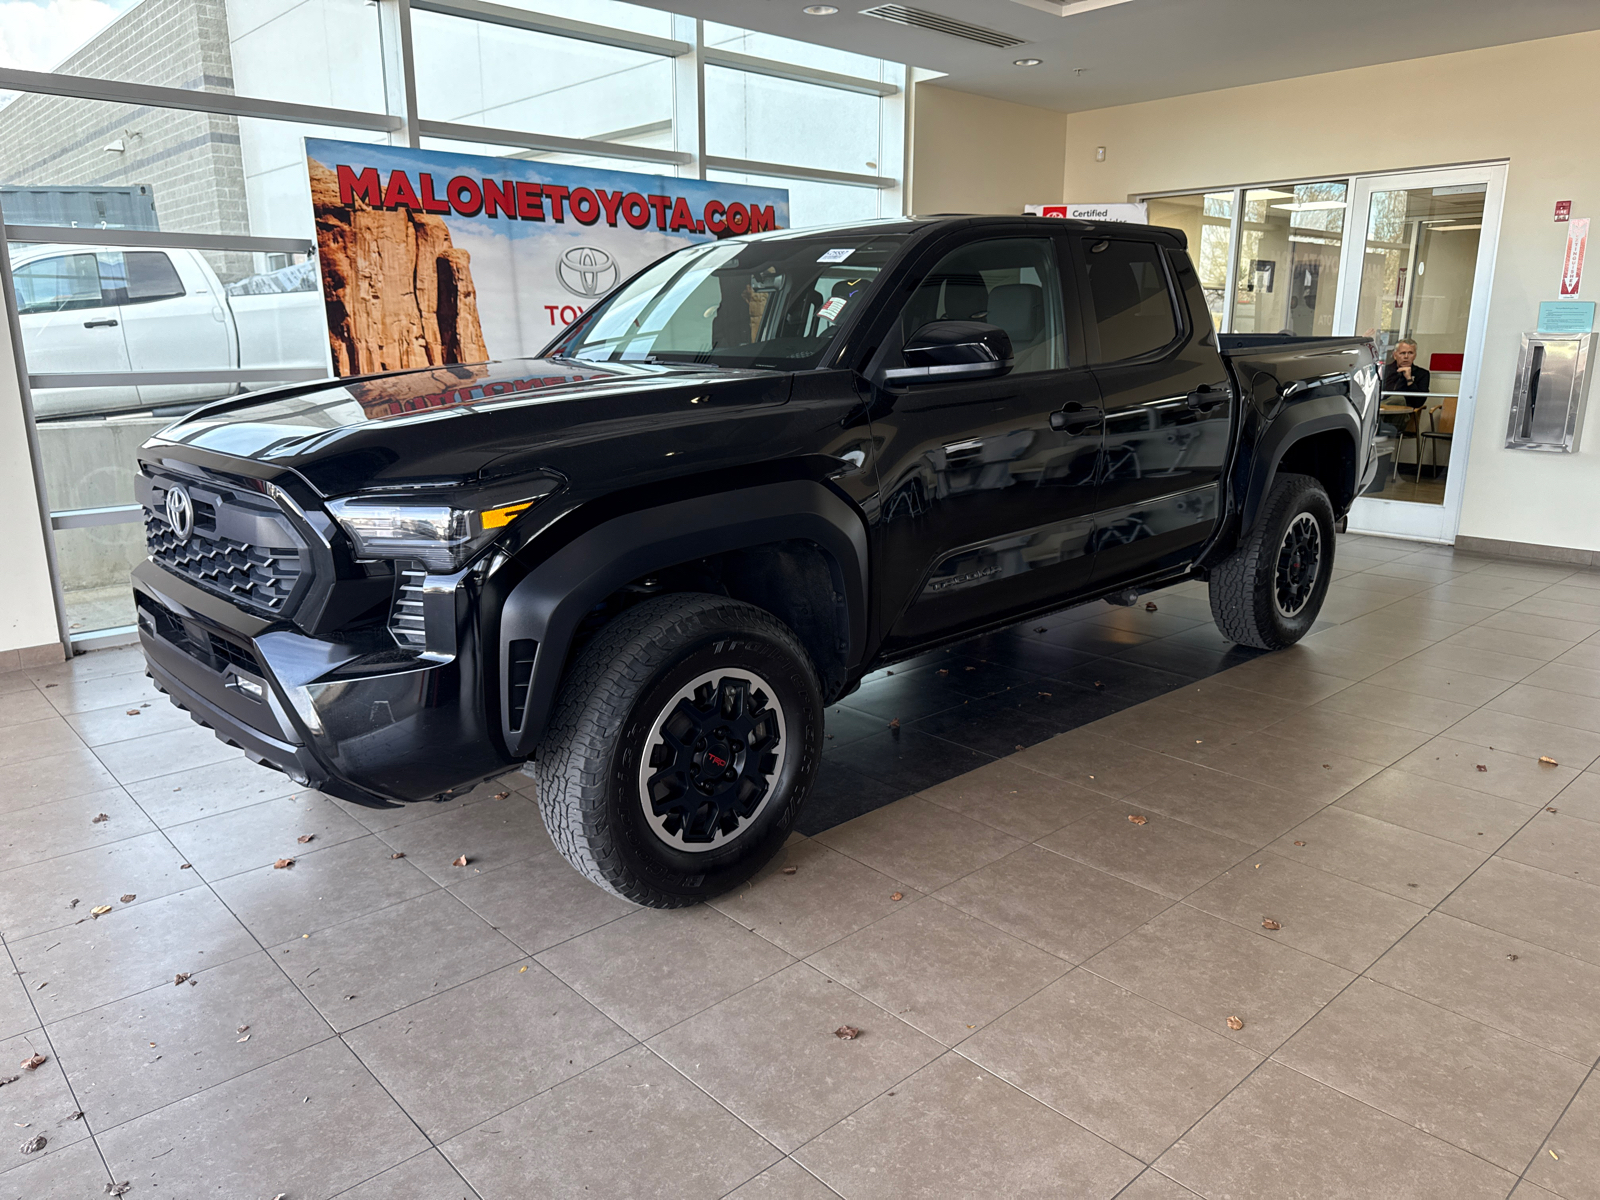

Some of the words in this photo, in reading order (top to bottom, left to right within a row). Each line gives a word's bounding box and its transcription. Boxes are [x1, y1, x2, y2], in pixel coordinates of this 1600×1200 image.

[336, 164, 775, 237] MALONETOYOTA.COM
[1072, 209, 1108, 217] Certified
[708, 752, 727, 767] TRD
